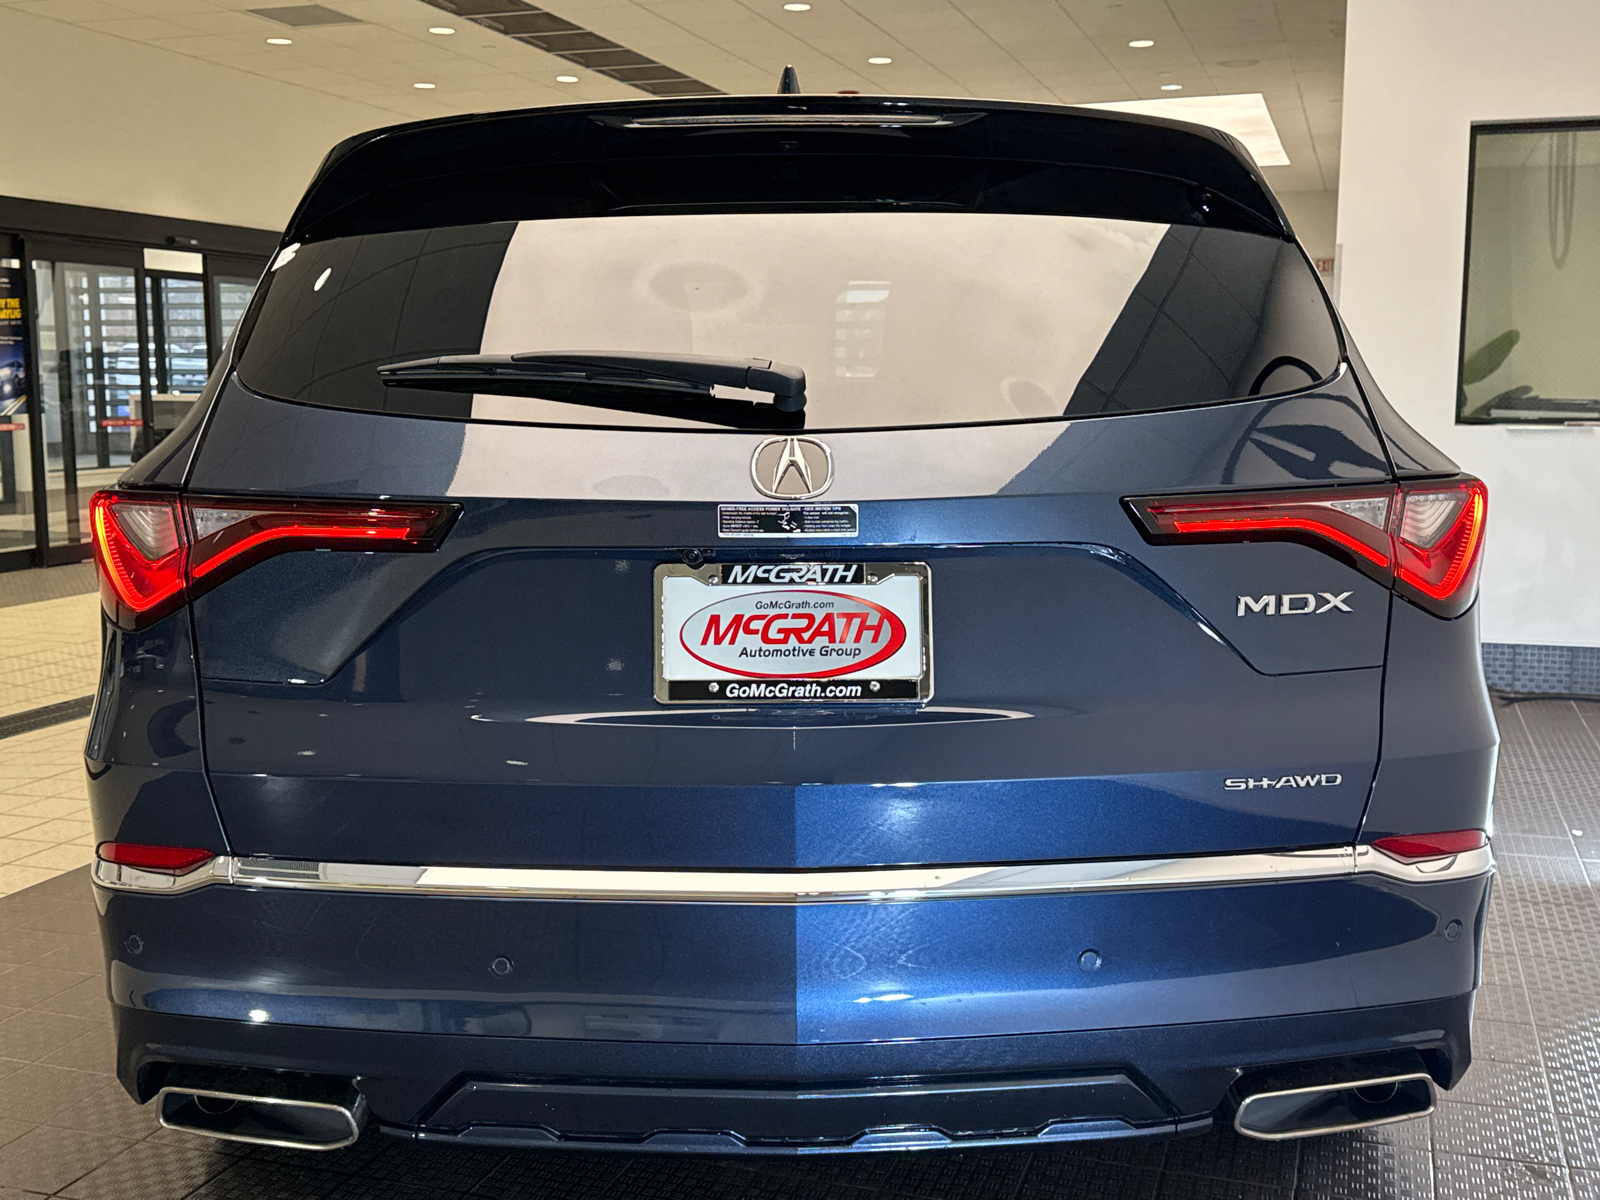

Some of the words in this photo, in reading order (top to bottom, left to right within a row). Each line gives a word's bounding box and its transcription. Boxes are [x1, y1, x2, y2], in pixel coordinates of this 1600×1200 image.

[728, 564, 857, 583] McGRATH
[755, 600, 834, 610] GoMcGrath.com
[1237, 591, 1354, 616] MDX
[700, 612, 885, 646] McGRATH
[738, 647, 815, 658] Automotive
[819, 645, 861, 659] Group
[725, 683, 862, 698] GoMcGrath.com
